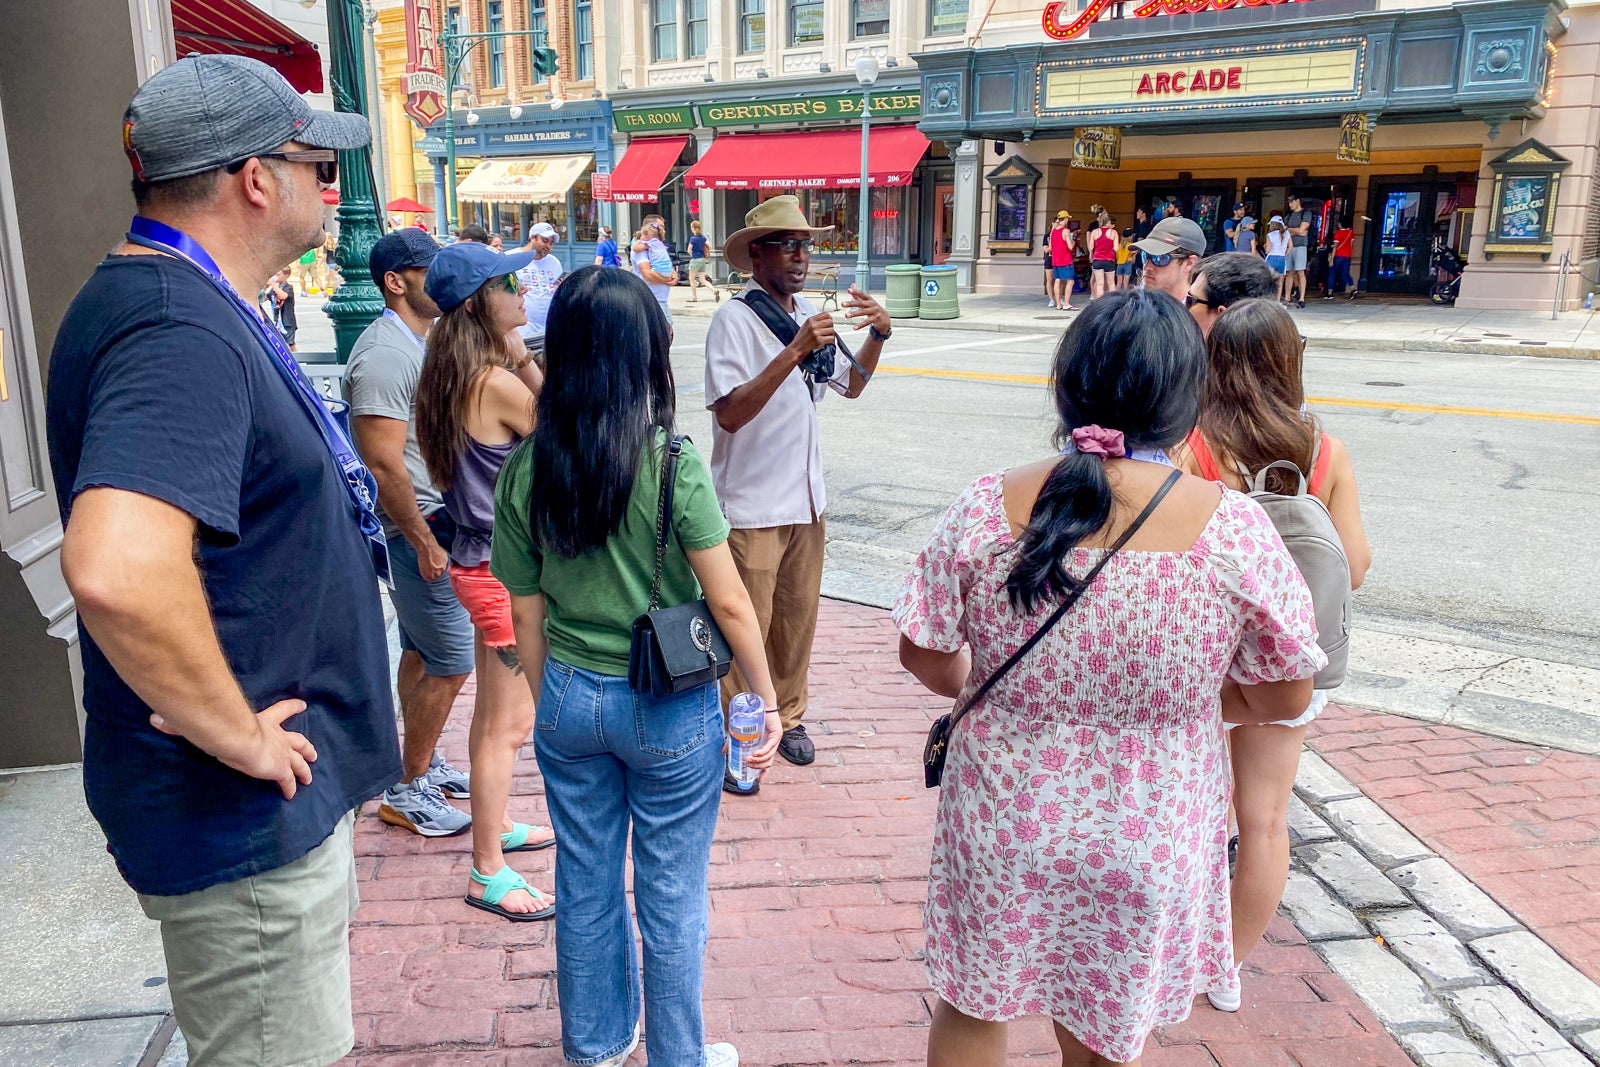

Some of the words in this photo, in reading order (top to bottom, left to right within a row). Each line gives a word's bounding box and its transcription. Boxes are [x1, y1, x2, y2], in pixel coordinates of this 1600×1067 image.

[410, 73, 446, 90] TRADERS
[1136, 66, 1243, 95] ARCADE
[708, 99, 827, 120] GERTNER'S
[624, 114, 645, 126] TEA
[648, 112, 682, 124] ROOM
[504, 133, 534, 142] SAHARA
[535, 131, 571, 140] TRADERS
[759, 178, 796, 187] GERTNER'S
[797, 177, 827, 187] BAKERY
[887, 175, 900, 183] 206
